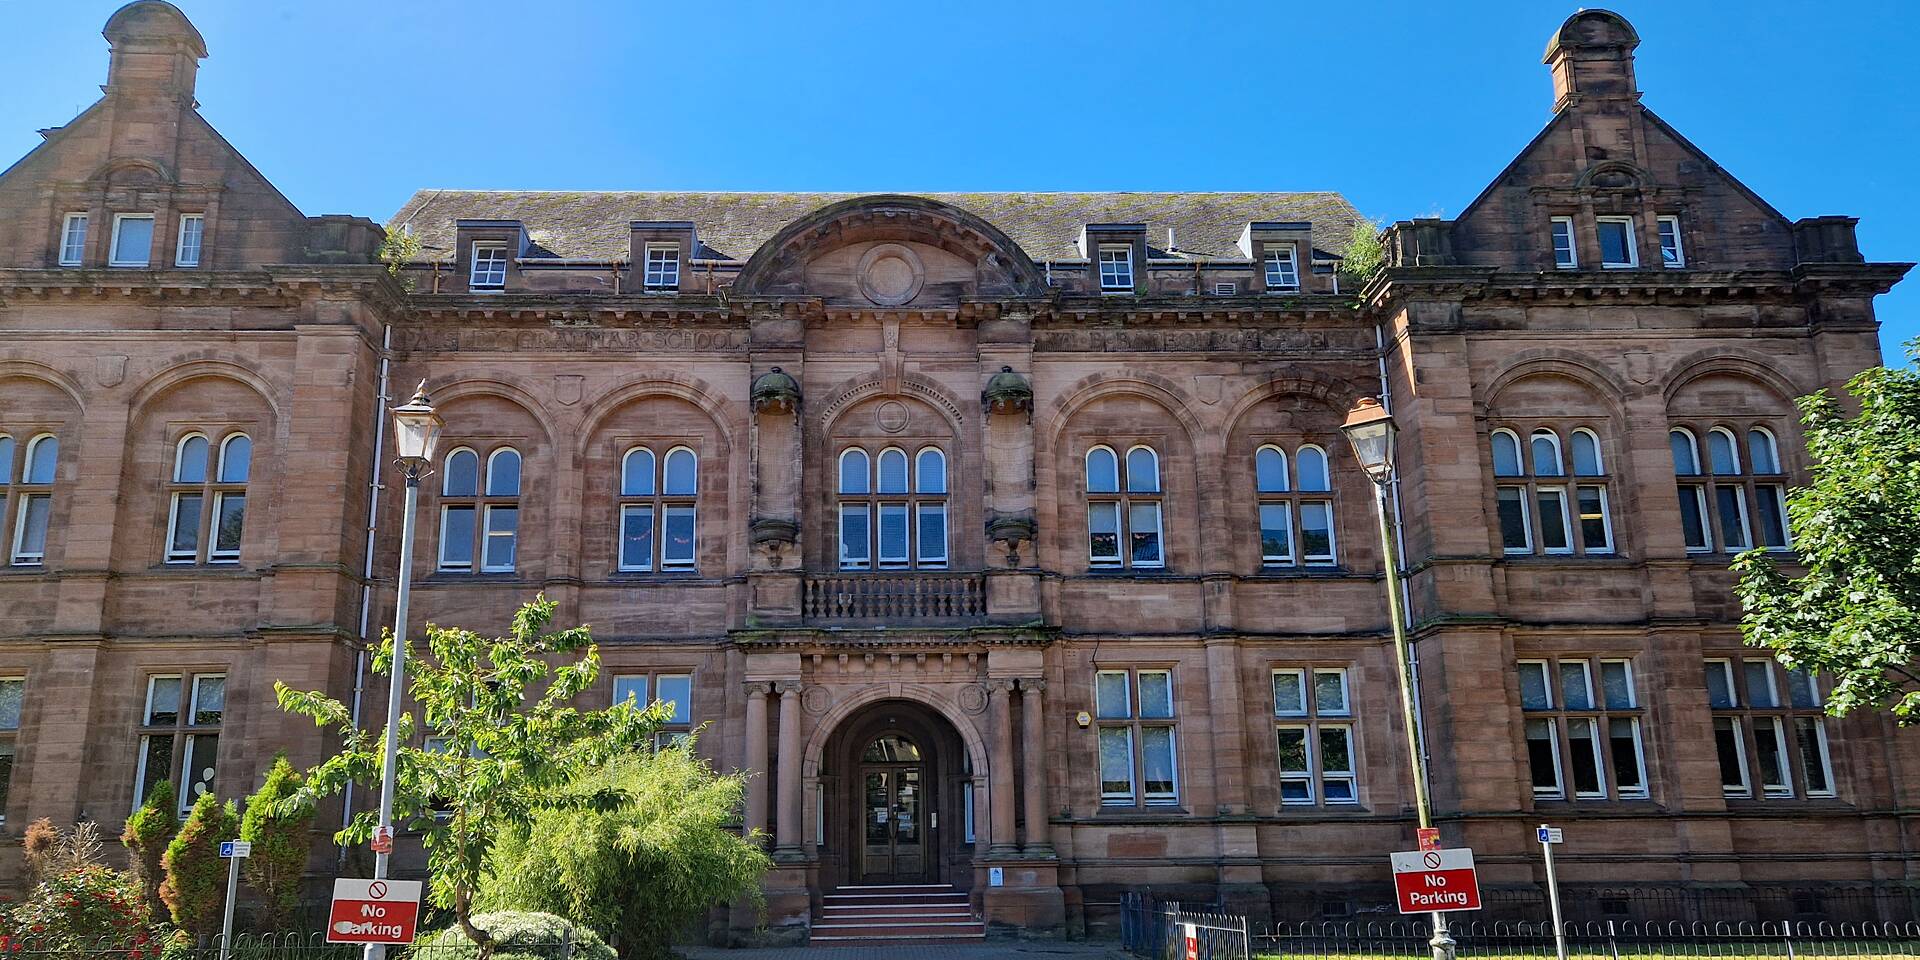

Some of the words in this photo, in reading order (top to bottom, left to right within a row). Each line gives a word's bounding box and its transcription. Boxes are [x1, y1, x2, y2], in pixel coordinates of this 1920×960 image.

[655, 330, 741, 349] SCHOOL
[1424, 874, 1447, 887] No
[1410, 891, 1467, 905] Parking
[361, 904, 386, 917] No
[335, 922, 402, 938] arking
